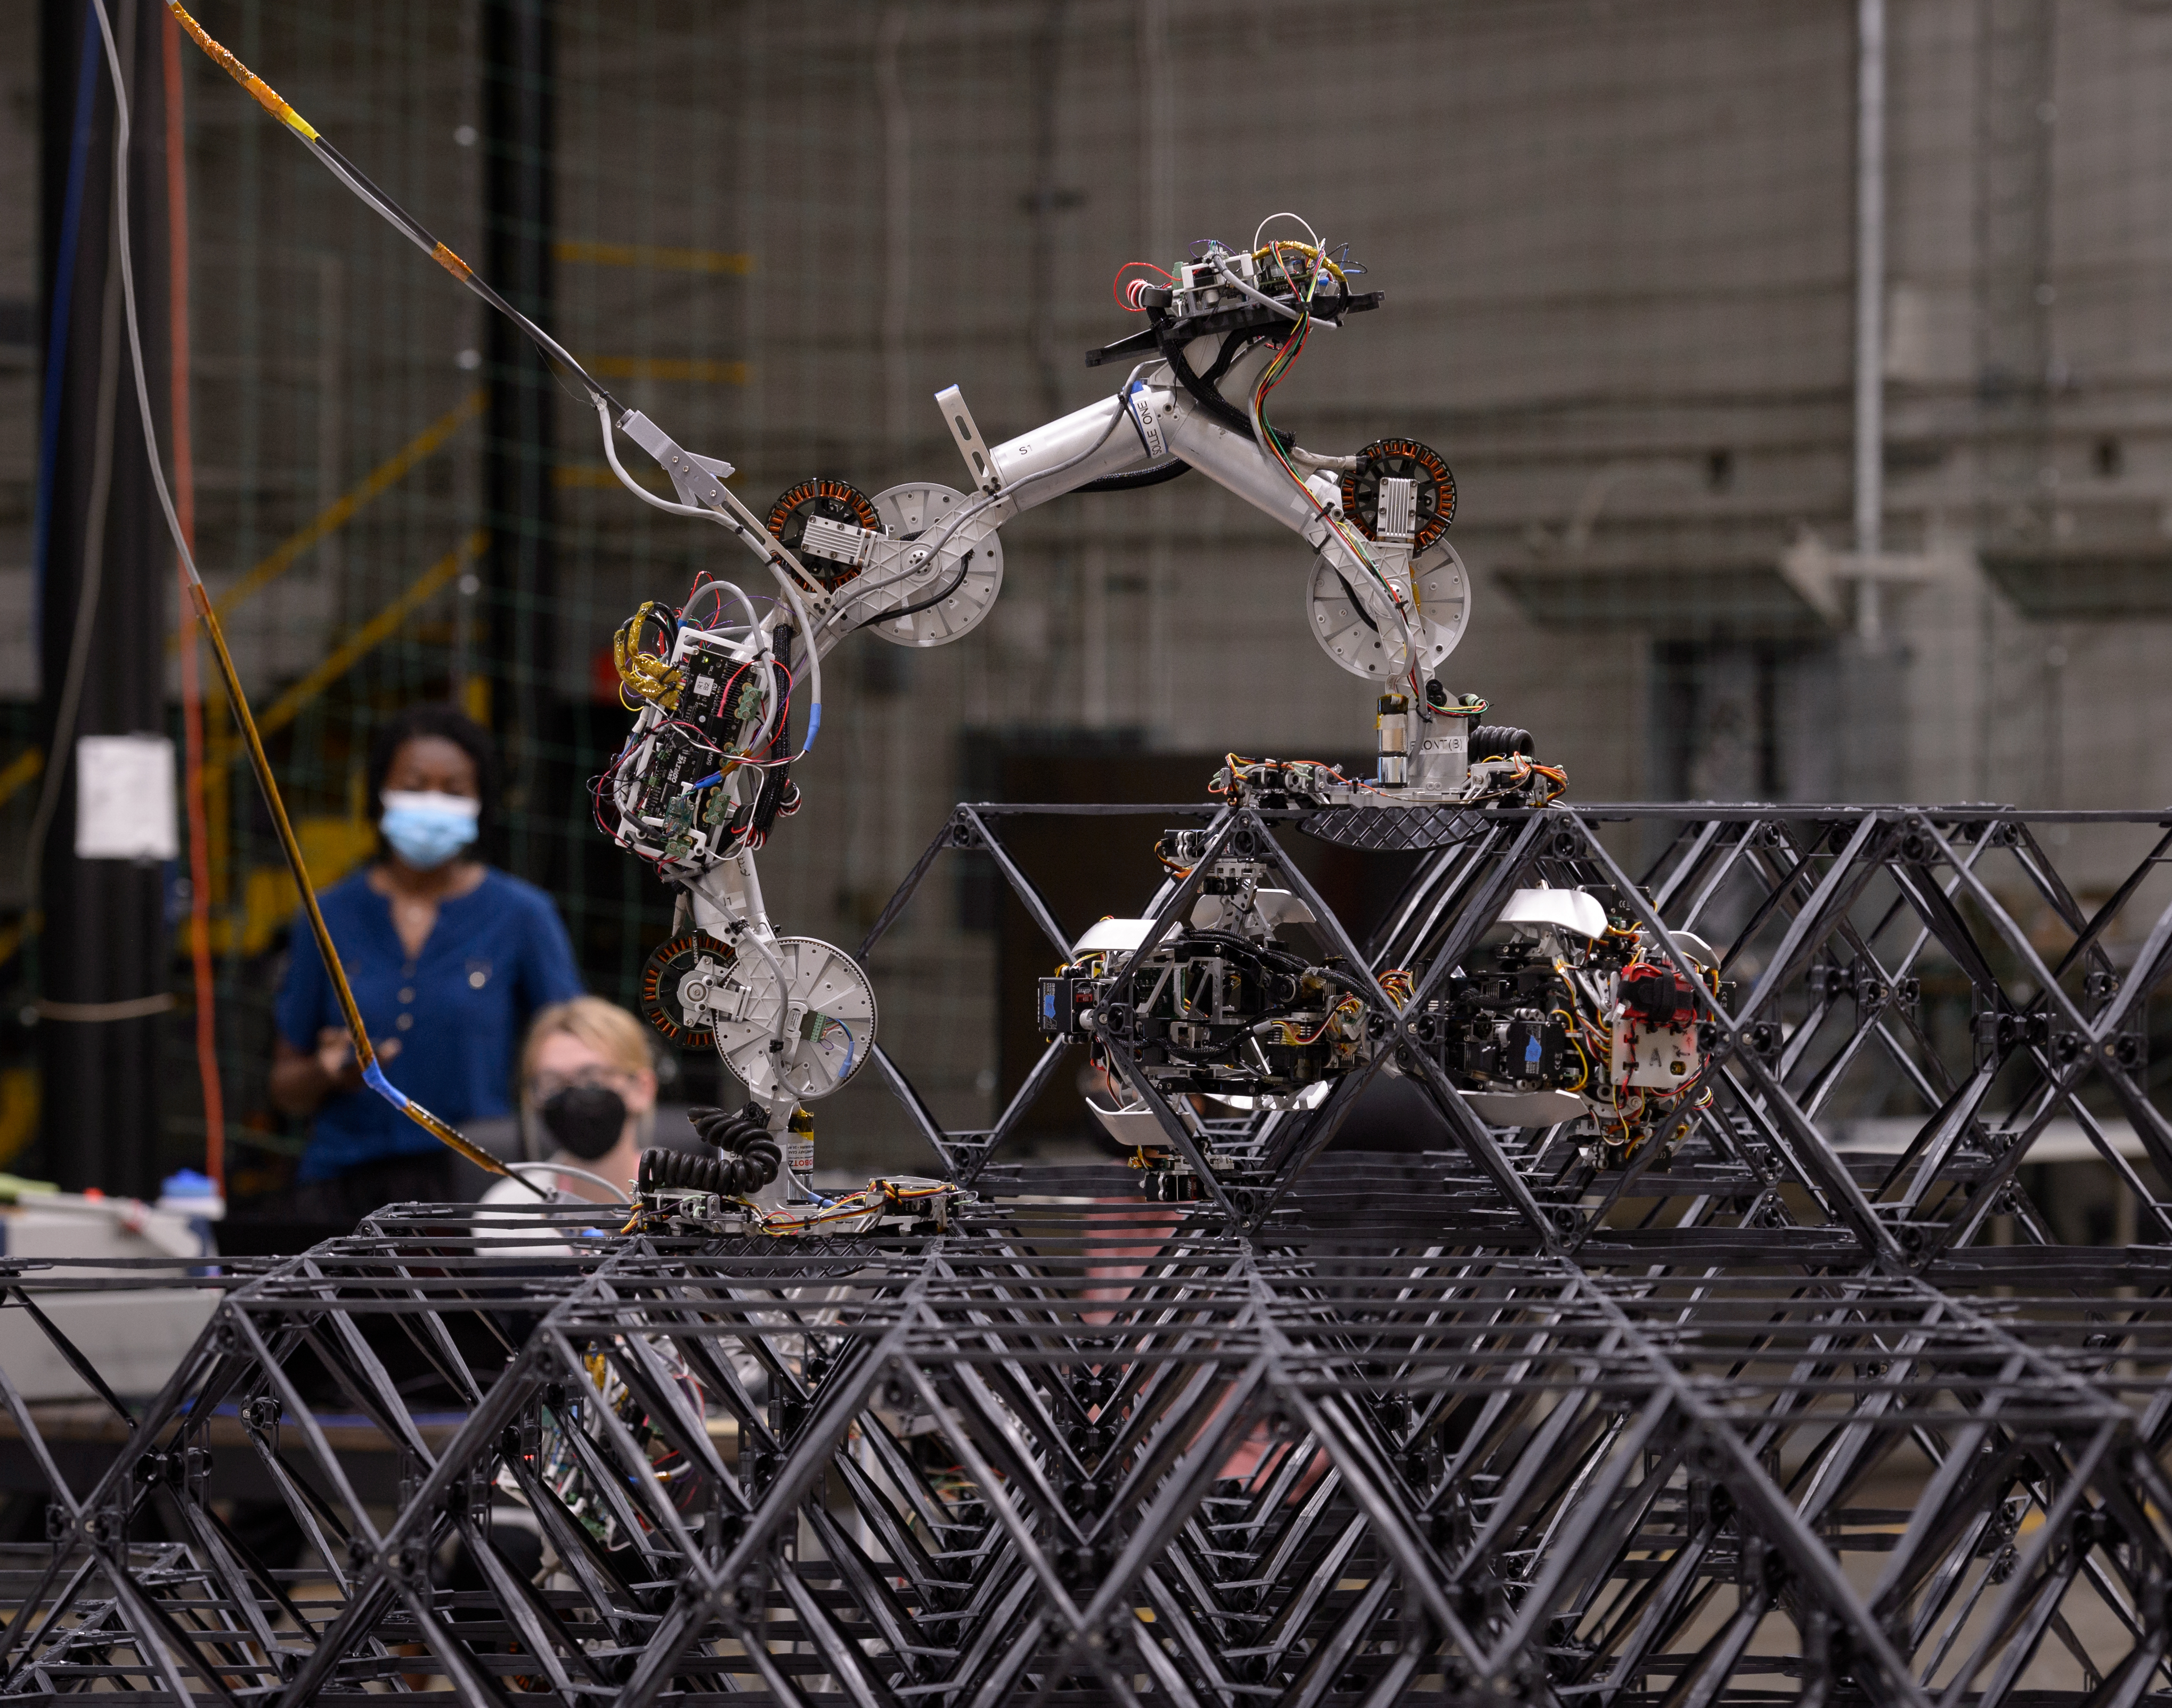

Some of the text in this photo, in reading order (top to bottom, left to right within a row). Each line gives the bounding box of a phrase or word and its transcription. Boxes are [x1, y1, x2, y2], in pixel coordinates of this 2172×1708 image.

[1137, 401, 1162, 456] SOLLE ONE
[1019, 444, 1032, 455] S1
[697, 681, 704, 689] R1
[703, 682, 710, 690] B2
[706, 737, 718, 766] 50WJ
[1410, 738, 1463, 752] FONT(B)
[671, 754, 684, 783] ODRIVE
[1649, 1047, 1662, 1067] A
